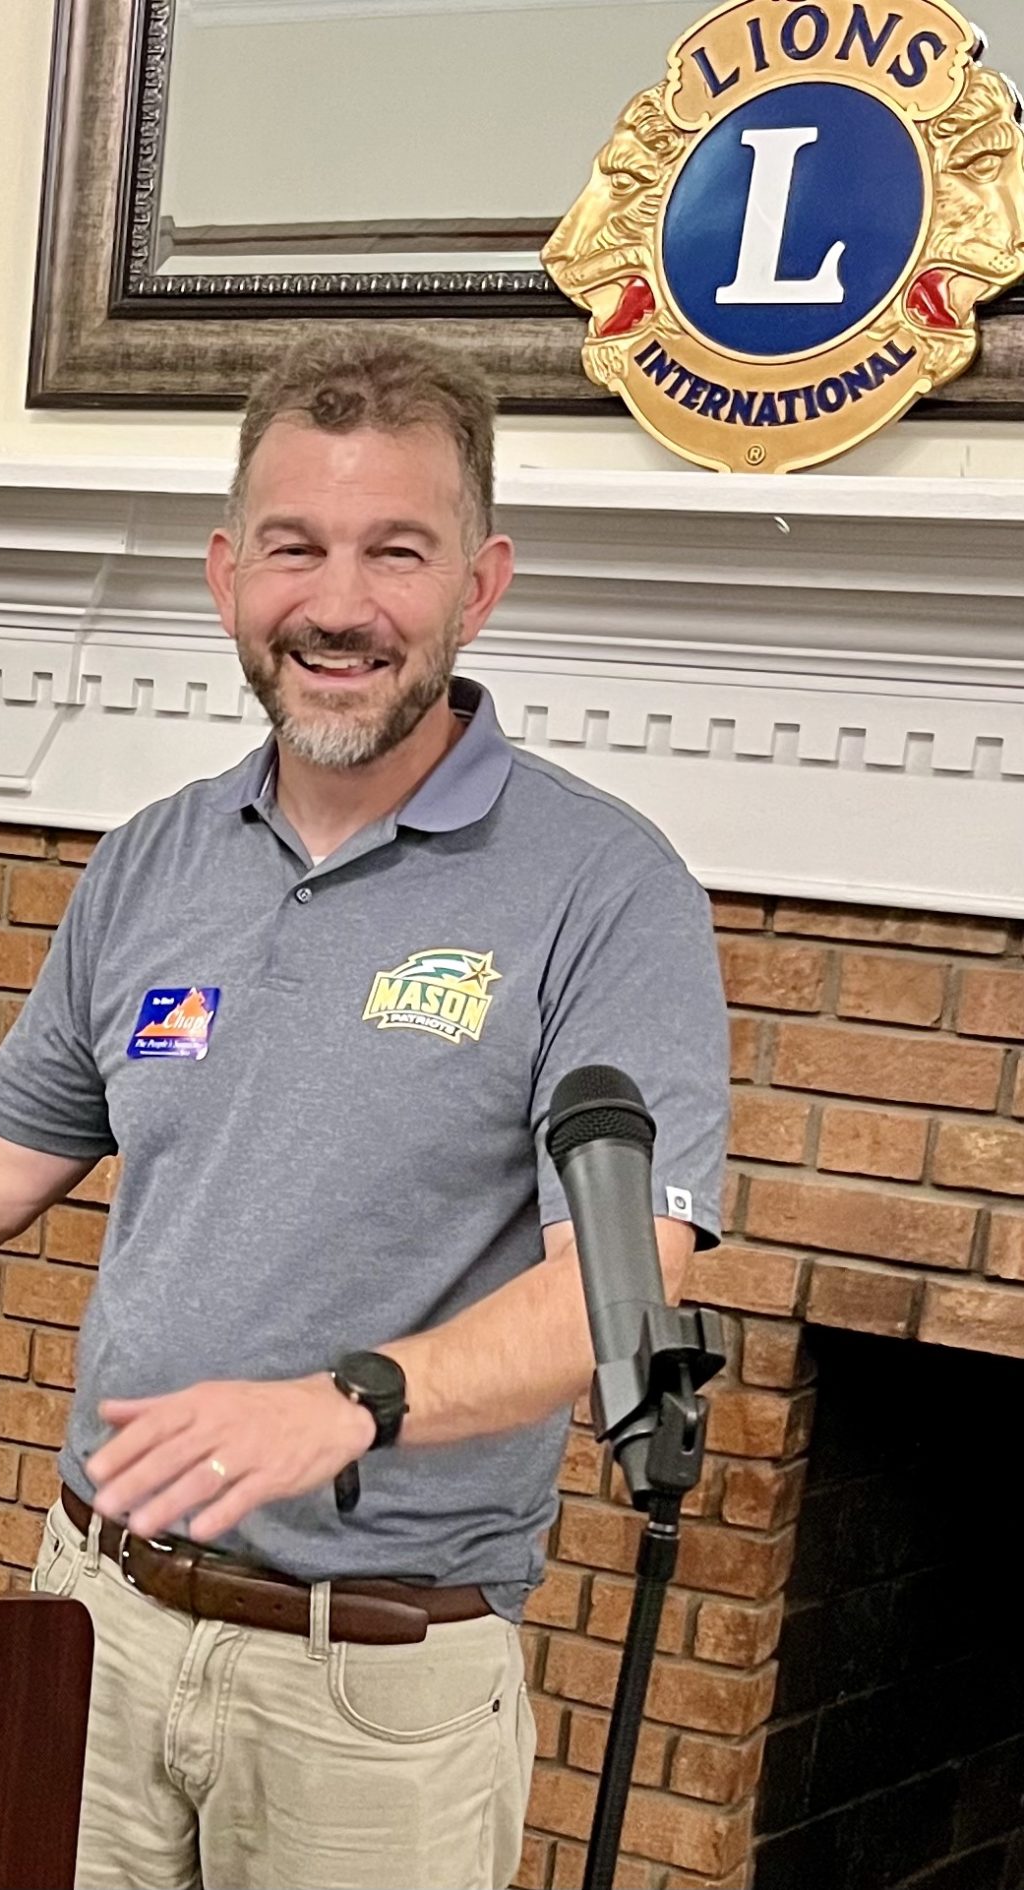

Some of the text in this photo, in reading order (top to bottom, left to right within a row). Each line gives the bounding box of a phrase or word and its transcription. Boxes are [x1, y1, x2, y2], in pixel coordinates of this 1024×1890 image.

[690, 4, 947, 98] LIONS
[714, 127, 846, 305] L
[633, 339, 916, 427] INTERNATIONAL
[371, 978, 488, 1032] MASON
[390, 1013, 456, 1036] PATRIOTS
